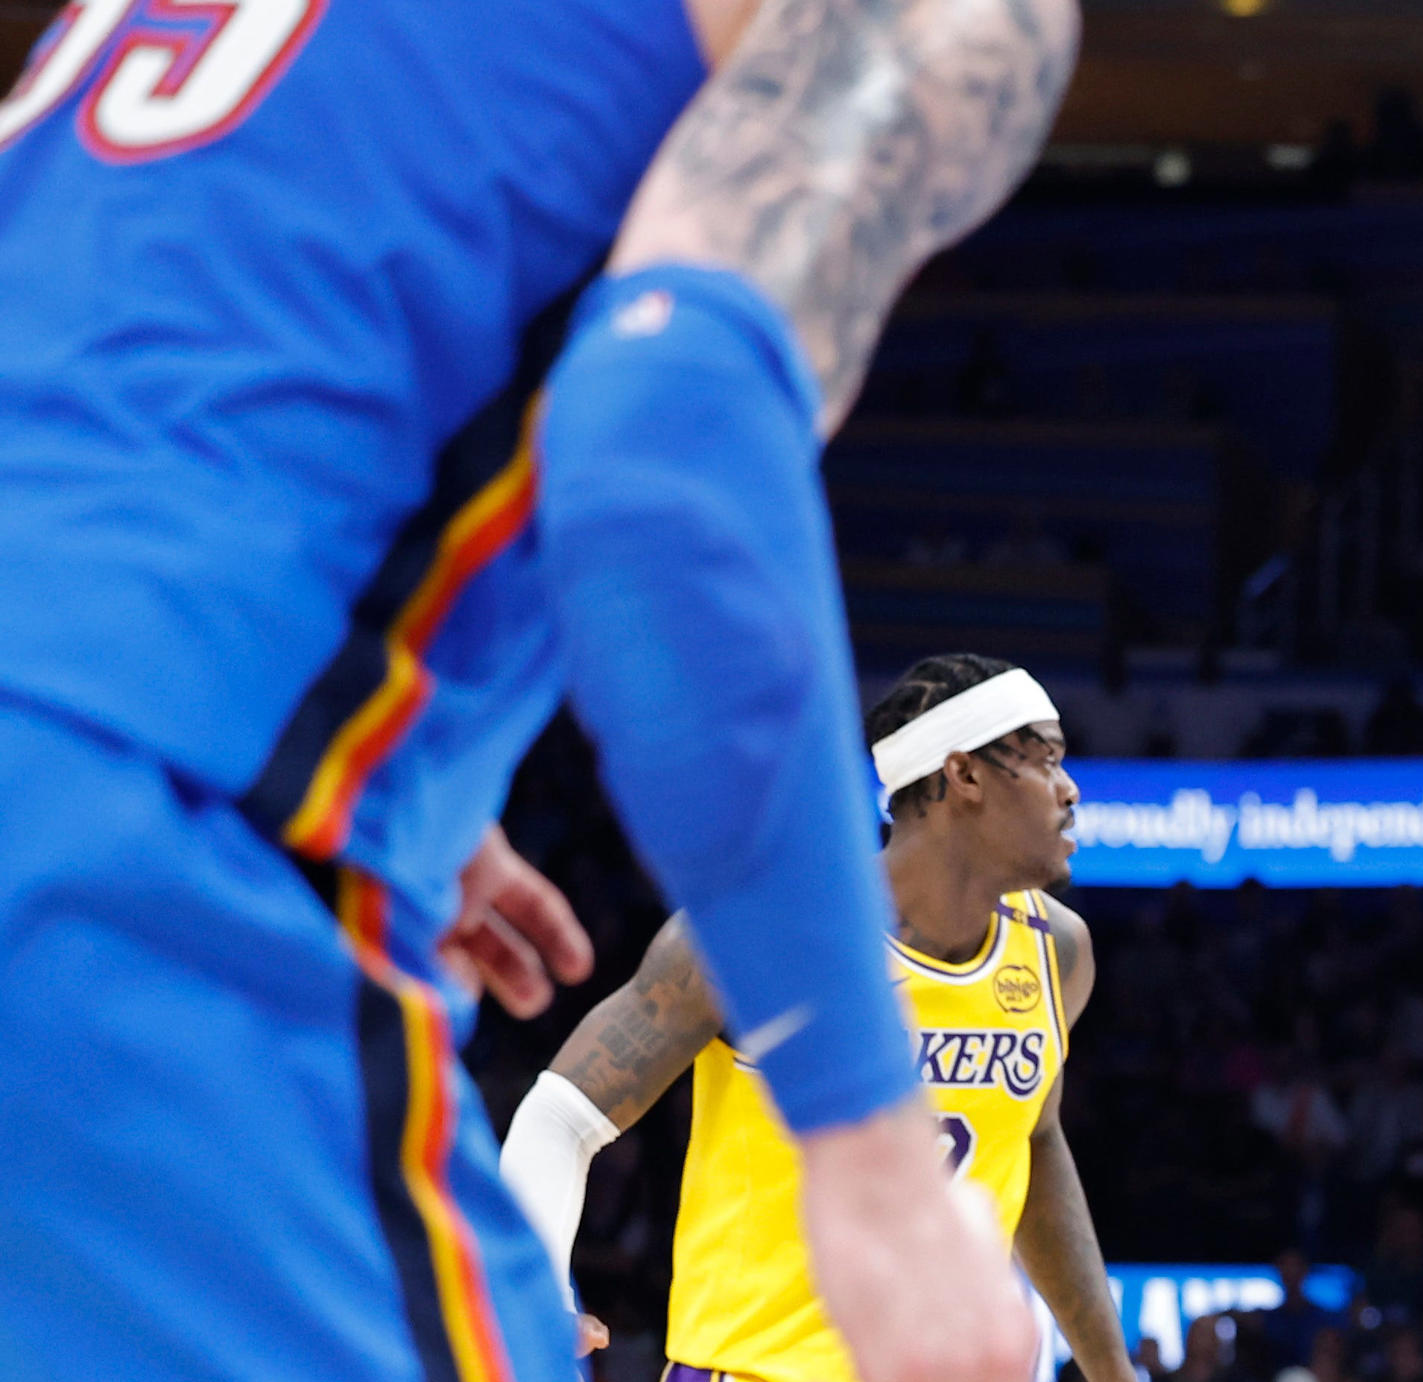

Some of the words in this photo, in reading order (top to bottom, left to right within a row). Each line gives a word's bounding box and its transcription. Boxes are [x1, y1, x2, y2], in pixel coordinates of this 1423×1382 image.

[0, 0, 330, 166] 5
[1076, 786, 1237, 864] roudly
[916, 1028, 1047, 1101] KERS
